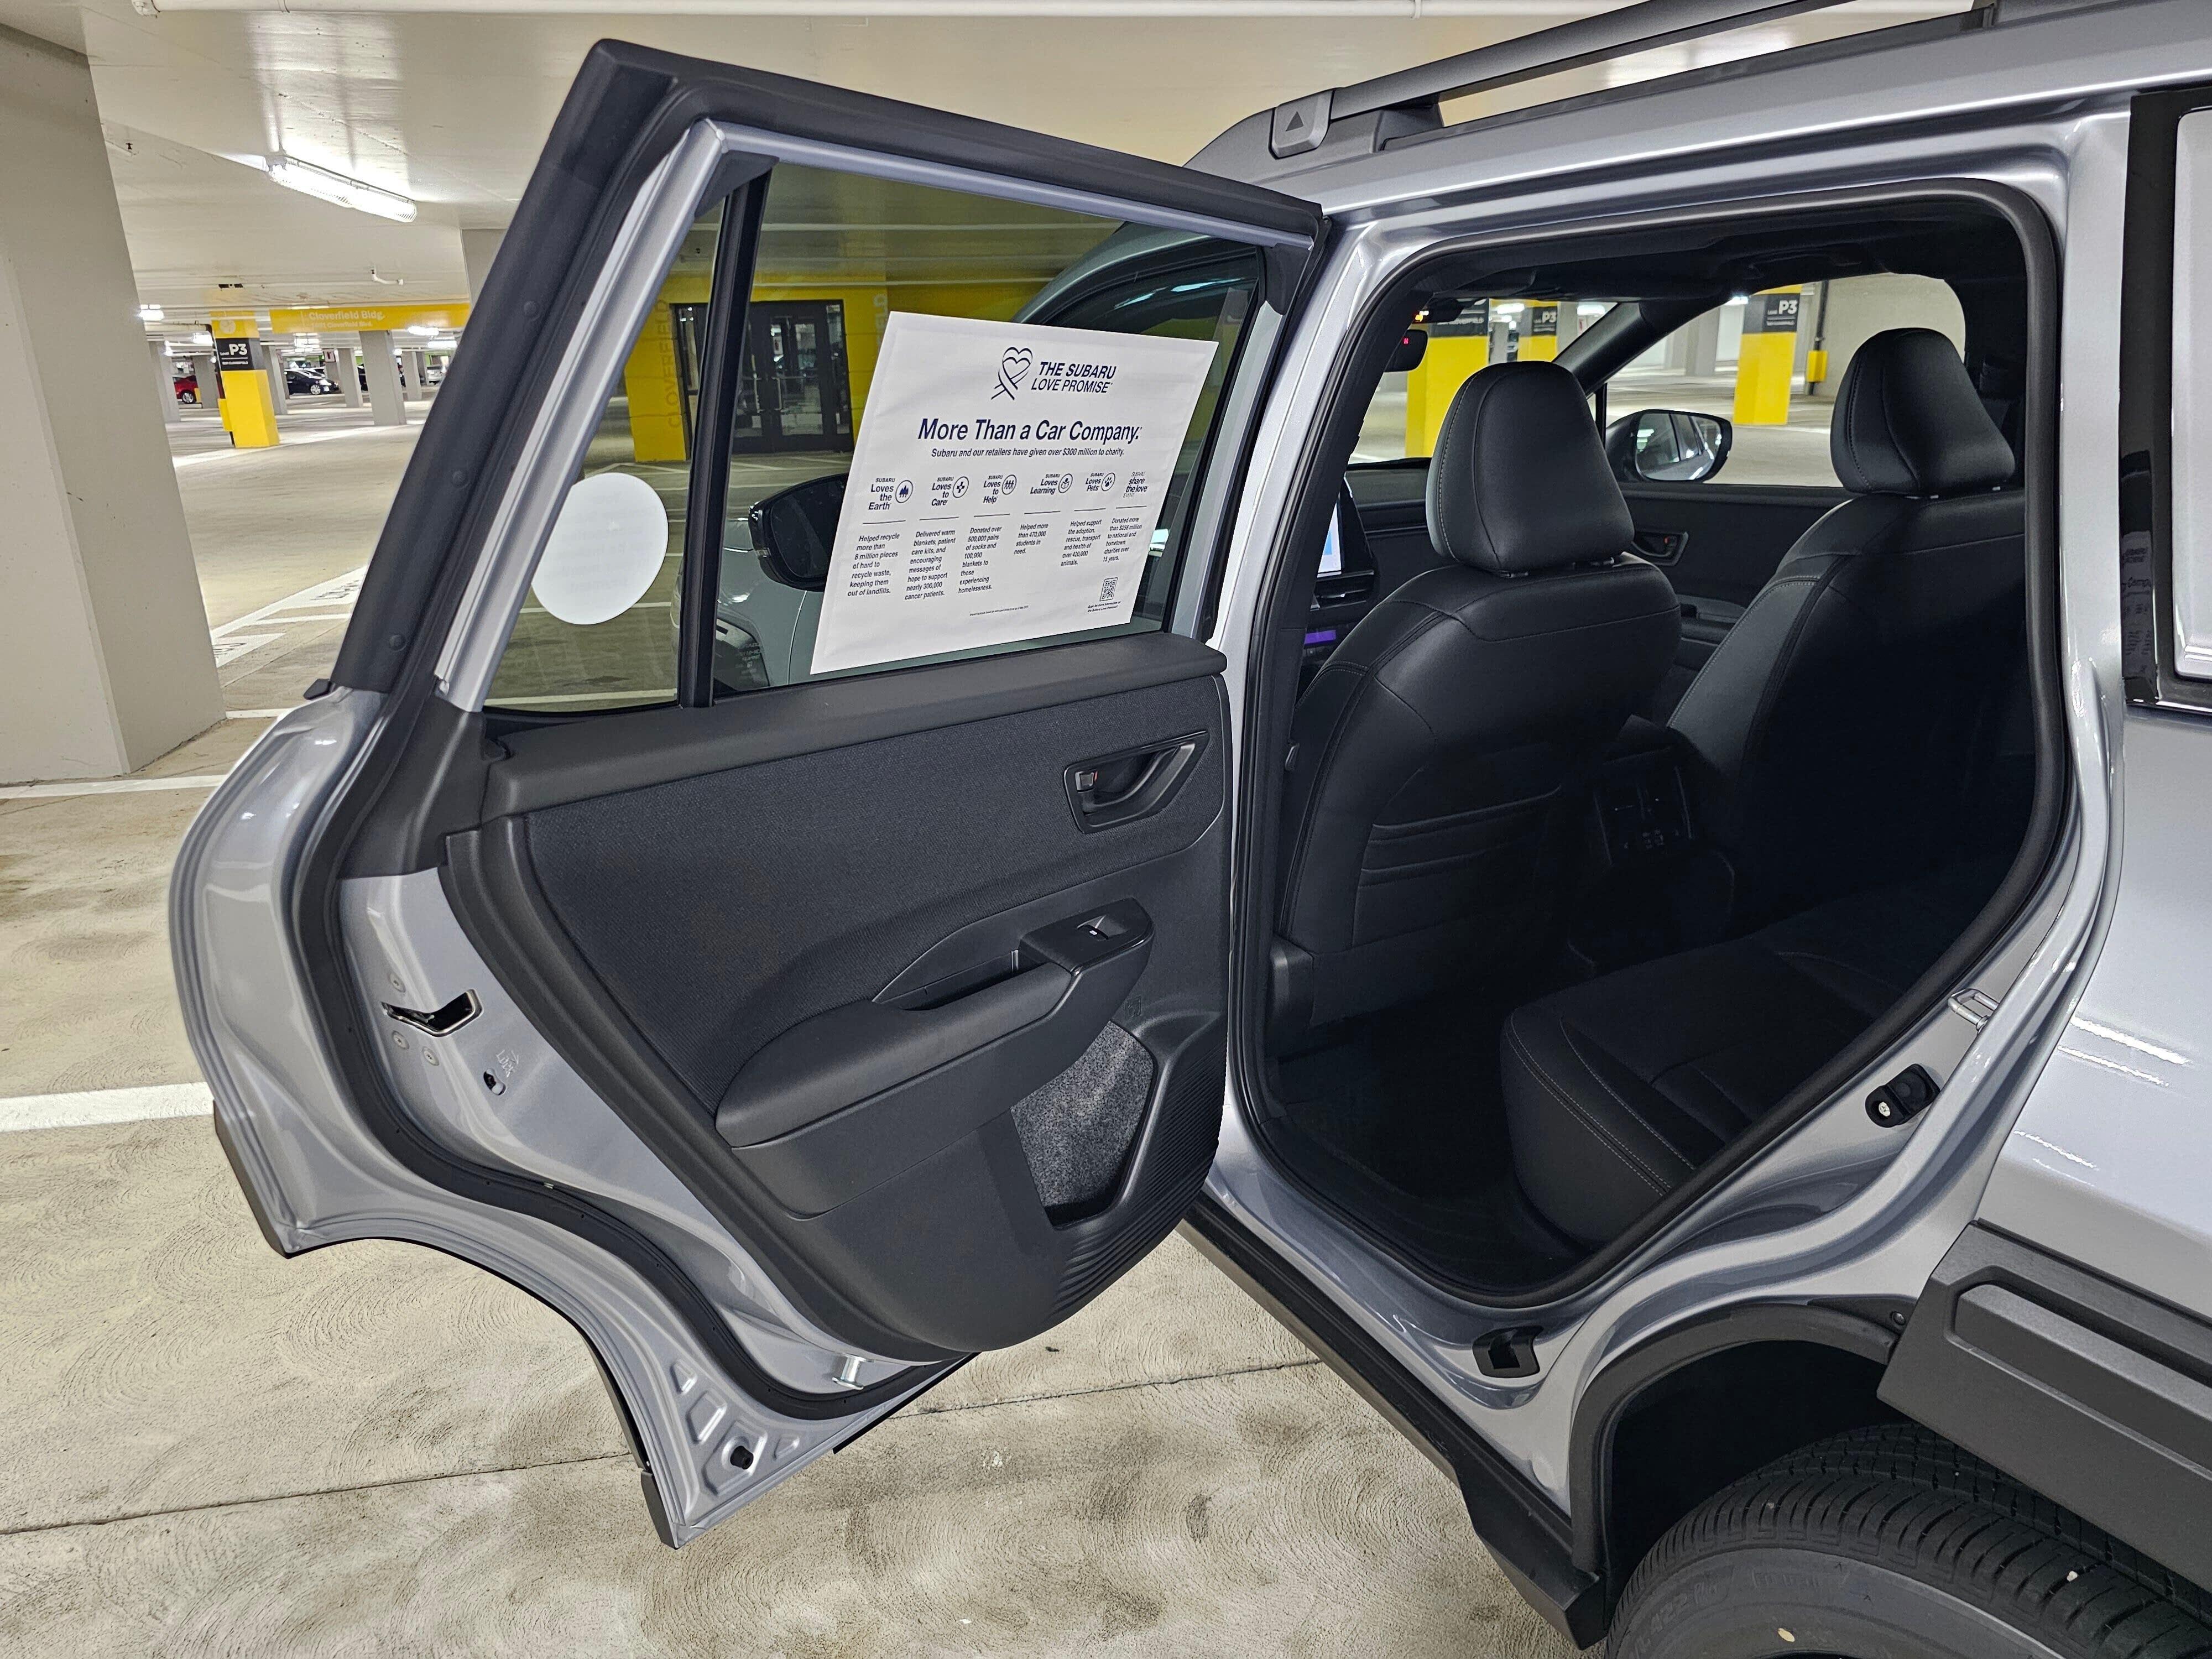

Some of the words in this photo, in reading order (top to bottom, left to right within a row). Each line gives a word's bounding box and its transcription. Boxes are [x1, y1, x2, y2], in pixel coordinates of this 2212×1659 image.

[1779, 300, 1798, 314] P3
[309, 311, 359, 320] Cloverfield
[361, 310, 385, 320] Bldg.
[1542, 311, 1557, 323] P3
[228, 343, 248, 355] P3
[1039, 362, 1065, 376] THE
[1066, 364, 1117, 379] SUBARU
[1031, 378, 1062, 390] LOVE
[1061, 380, 1110, 393] PROMISE
[918, 419, 968, 440] More
[975, 419, 1015, 440] Than
[1020, 425, 1031, 440] a
[1036, 420, 1066, 440] Car
[1070, 421, 1139, 445] Company.
[932, 448, 957, 457] Subaru
[959, 448, 972, 457] and
[1029, 448, 1046, 457] given
[1105, 448, 1124, 457] charity.
[871, 484, 894, 492] Loves
[852, 571, 872, 580] recycle
[960, 577, 989, 585] experiencing
[958, 585, 992, 593] homelessness.
[924, 591, 945, 599] patients.
[495, 1050, 514, 1078] LOCK
